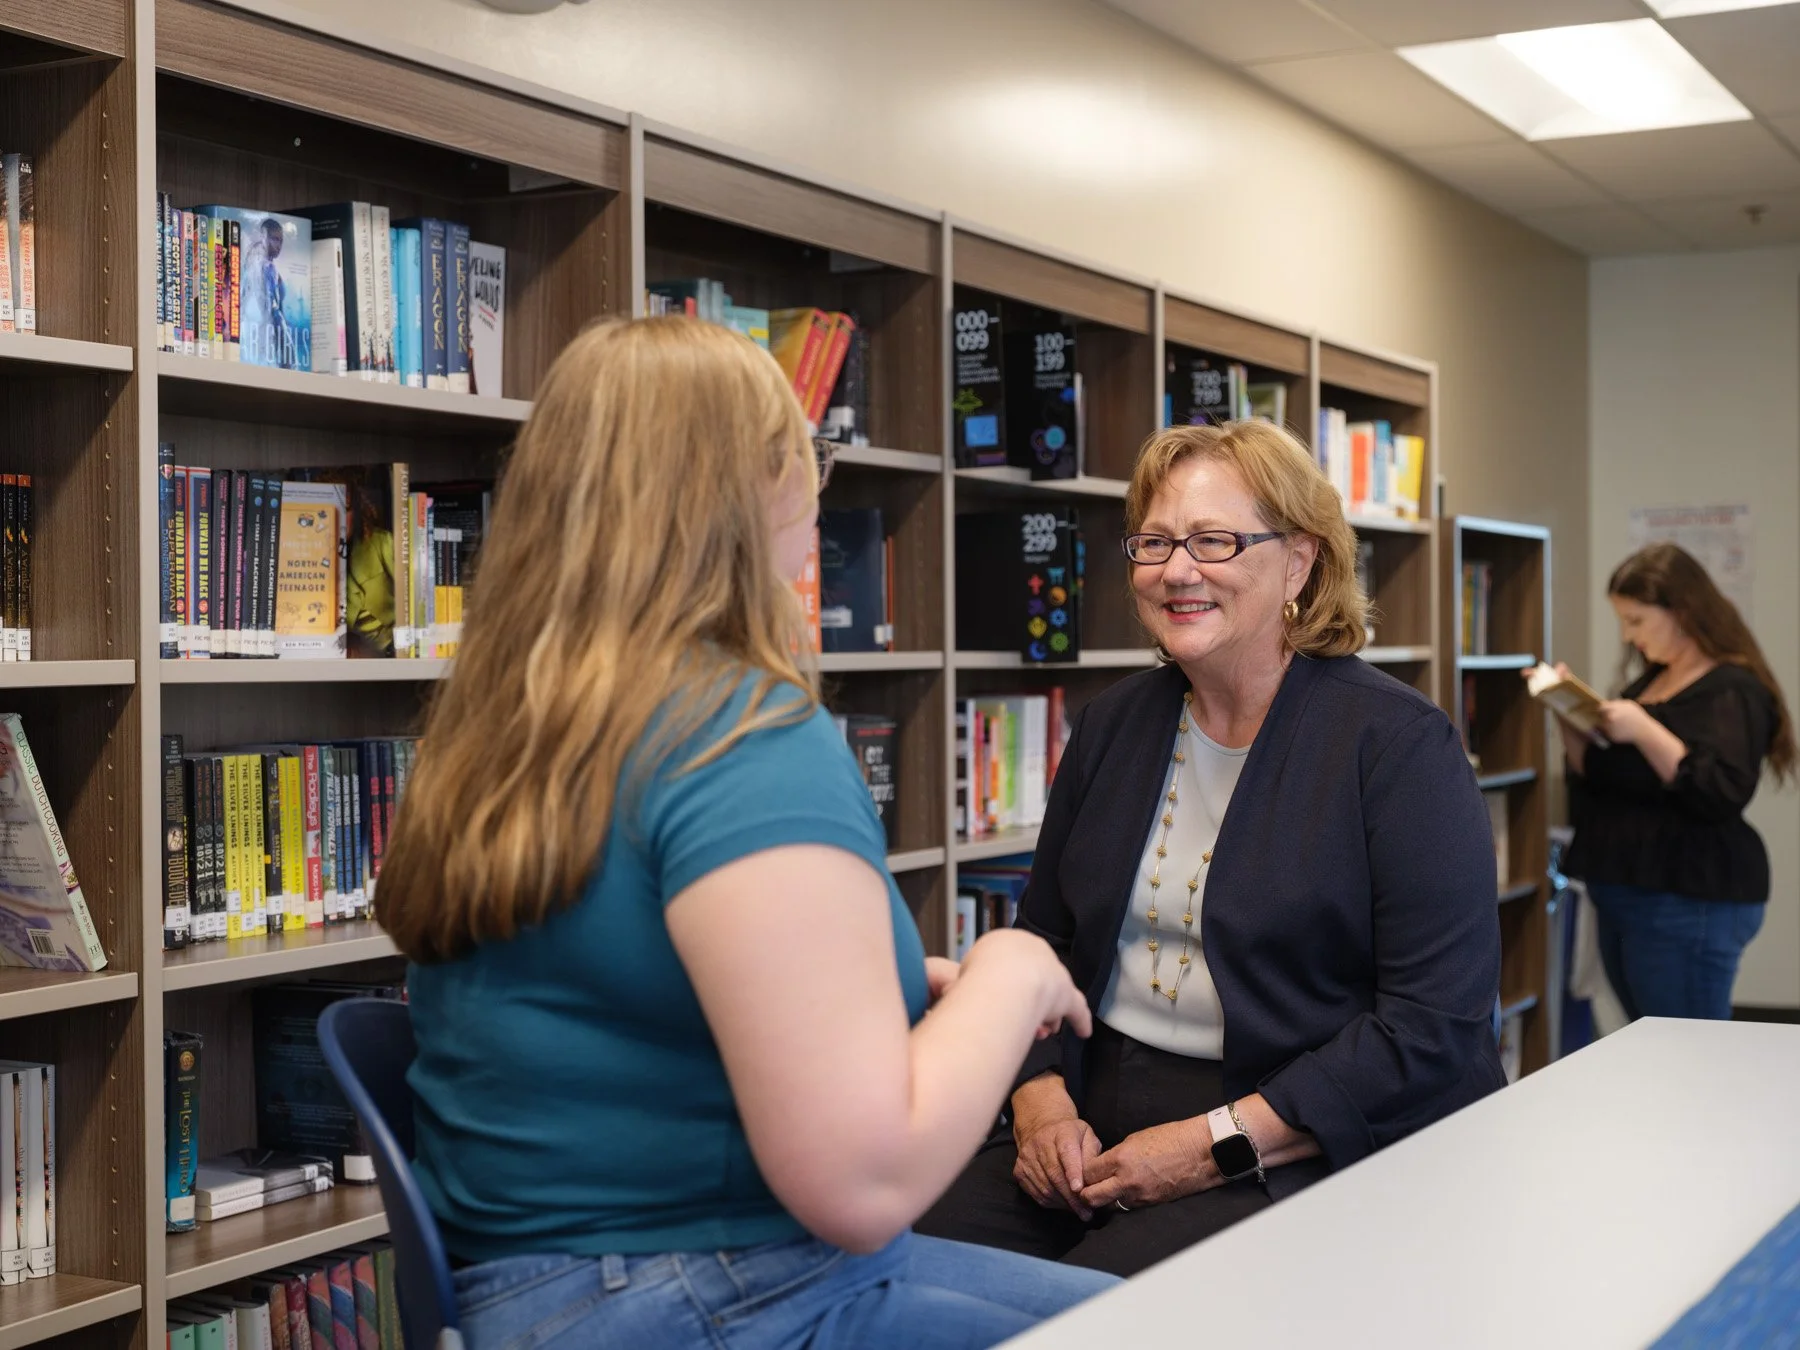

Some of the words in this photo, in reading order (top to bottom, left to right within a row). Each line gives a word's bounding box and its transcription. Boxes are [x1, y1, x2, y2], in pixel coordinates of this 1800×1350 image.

[172, 236, 180, 274] SCOTT
[185, 239, 193, 277] SCOTT
[200, 241, 208, 280] SCOTT
[215, 243, 223, 281] SCOTT
[231, 245, 239, 284] SCOTT
[173, 276, 181, 327] PILGRIM
[185, 279, 193, 330] PILGRIM
[200, 281, 208, 332] PILGRIM
[215, 283, 223, 333] PILGRIM
[231, 285, 239, 337] PILGRIM
[431, 253, 444, 350] ERAGON
[455, 257, 468, 352] ERAGON
[265, 323, 310, 368] GIRLS
[955, 330, 990, 351] 099
[401, 468, 410, 501] JODI
[176, 511, 185, 556] FORWARD
[199, 511, 209, 556] FORWARD
[401, 507, 409, 564] PICOULT
[1022, 532, 1057, 552] 299
[162, 528, 170, 603] DAWNBREAKER
[168, 518, 176, 613] SUPERMAN
[176, 557, 185, 571] ME
[199, 557, 209, 571] ME
[279, 571, 326, 580] AMERICAN
[287, 560, 318, 568] NORTH
[176, 573, 185, 599] BACK
[199, 574, 209, 599] BACK
[278, 583, 326, 592] TEENAGER
[177, 613, 185, 625] YO
[199, 614, 209, 625] YO
[241, 763, 249, 781] THE
[254, 763, 262, 781] THE
[307, 753, 315, 770] The
[15, 731, 36, 776] CLASSIC
[31, 774, 50, 812] DUTCH
[44, 809, 66, 858] COOKING
[229, 783, 237, 812] SILVER
[242, 783, 250, 811] SILVER
[254, 783, 262, 811] SILVER
[306, 772, 319, 827] Radleys
[326, 772, 335, 801] MILES
[353, 794, 361, 824] REYNOLDS
[230, 814, 239, 849] LININGS
[242, 814, 251, 848] LININGS
[255, 814, 264, 848] LININGS
[326, 806, 336, 855] MORALES
[168, 857, 185, 887] BOOK
[168, 890, 185, 907] DE
[179, 1109, 192, 1145] LOST
[178, 1148, 191, 1193] HERO
